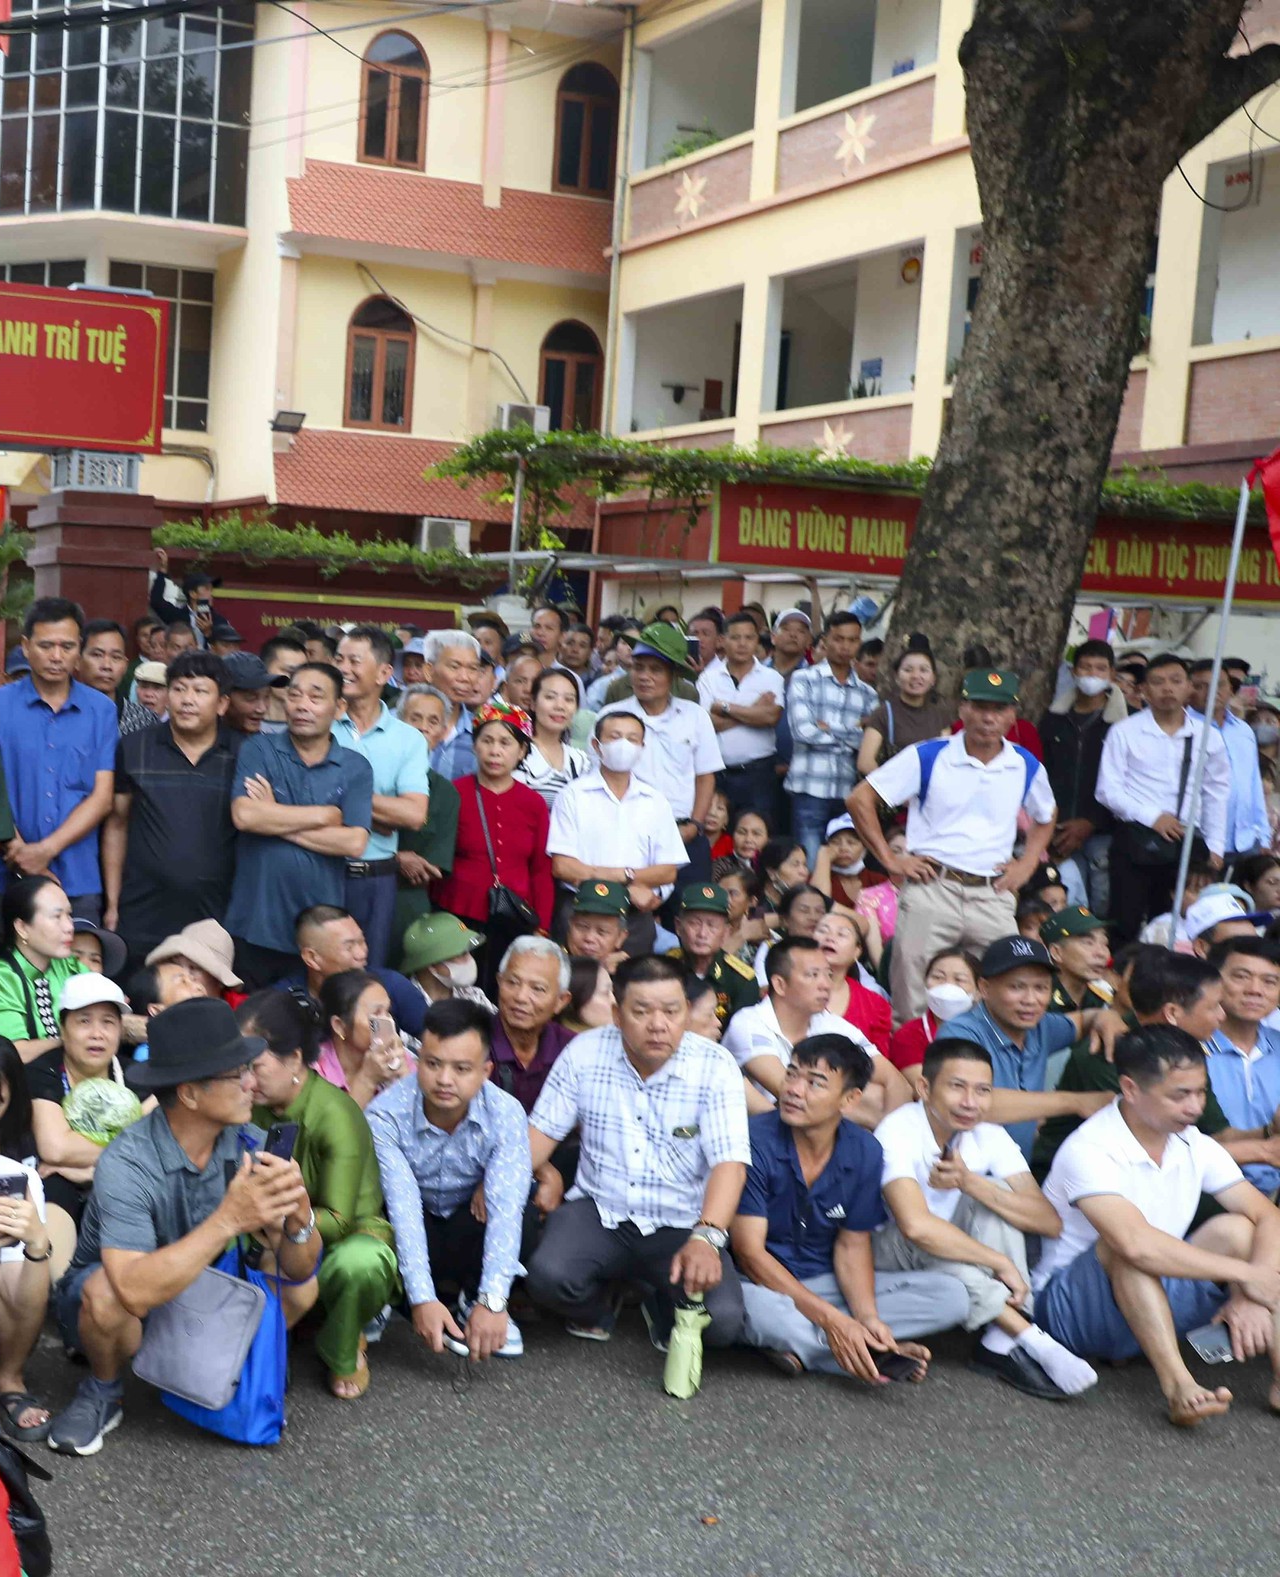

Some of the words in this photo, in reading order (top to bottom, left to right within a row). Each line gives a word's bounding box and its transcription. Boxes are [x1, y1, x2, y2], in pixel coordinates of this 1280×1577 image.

[44, 319, 80, 361] TRÍ
[86, 324, 127, 373] TUỆ
[738, 494, 792, 549] ĐẢNG
[797, 504, 846, 554] VỮNG
[1158, 535, 1189, 587] TỘC
